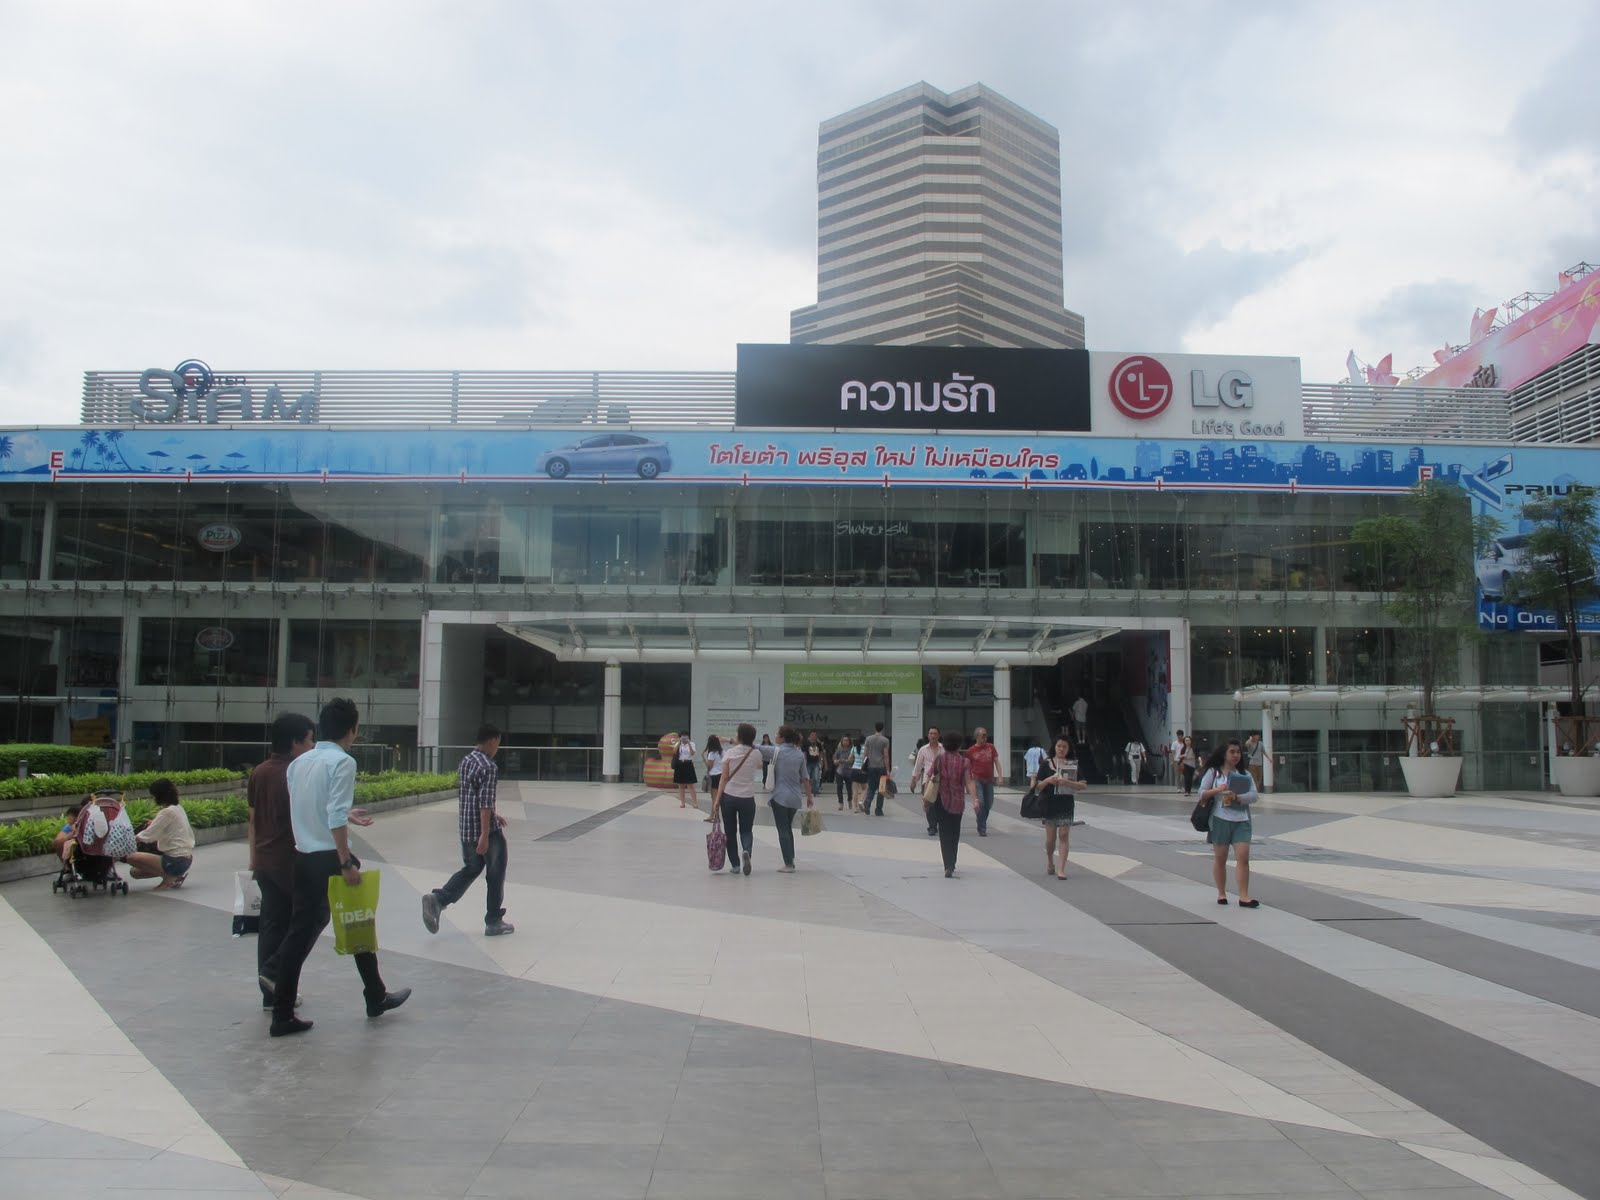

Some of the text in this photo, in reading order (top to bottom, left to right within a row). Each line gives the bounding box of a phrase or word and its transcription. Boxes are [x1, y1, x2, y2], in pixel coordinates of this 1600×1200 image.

[841, 372, 996, 413] ความรัก
[1191, 369, 1253, 409] LG
[1192, 419, 1285, 437] Life's Good
[51, 451, 64, 469] E
[709, 444, 789, 465] โตโยต้า
[875, 445, 916, 467] ใหม่
[1480, 611, 1508, 624] No
[1517, 611, 1556, 624] One
